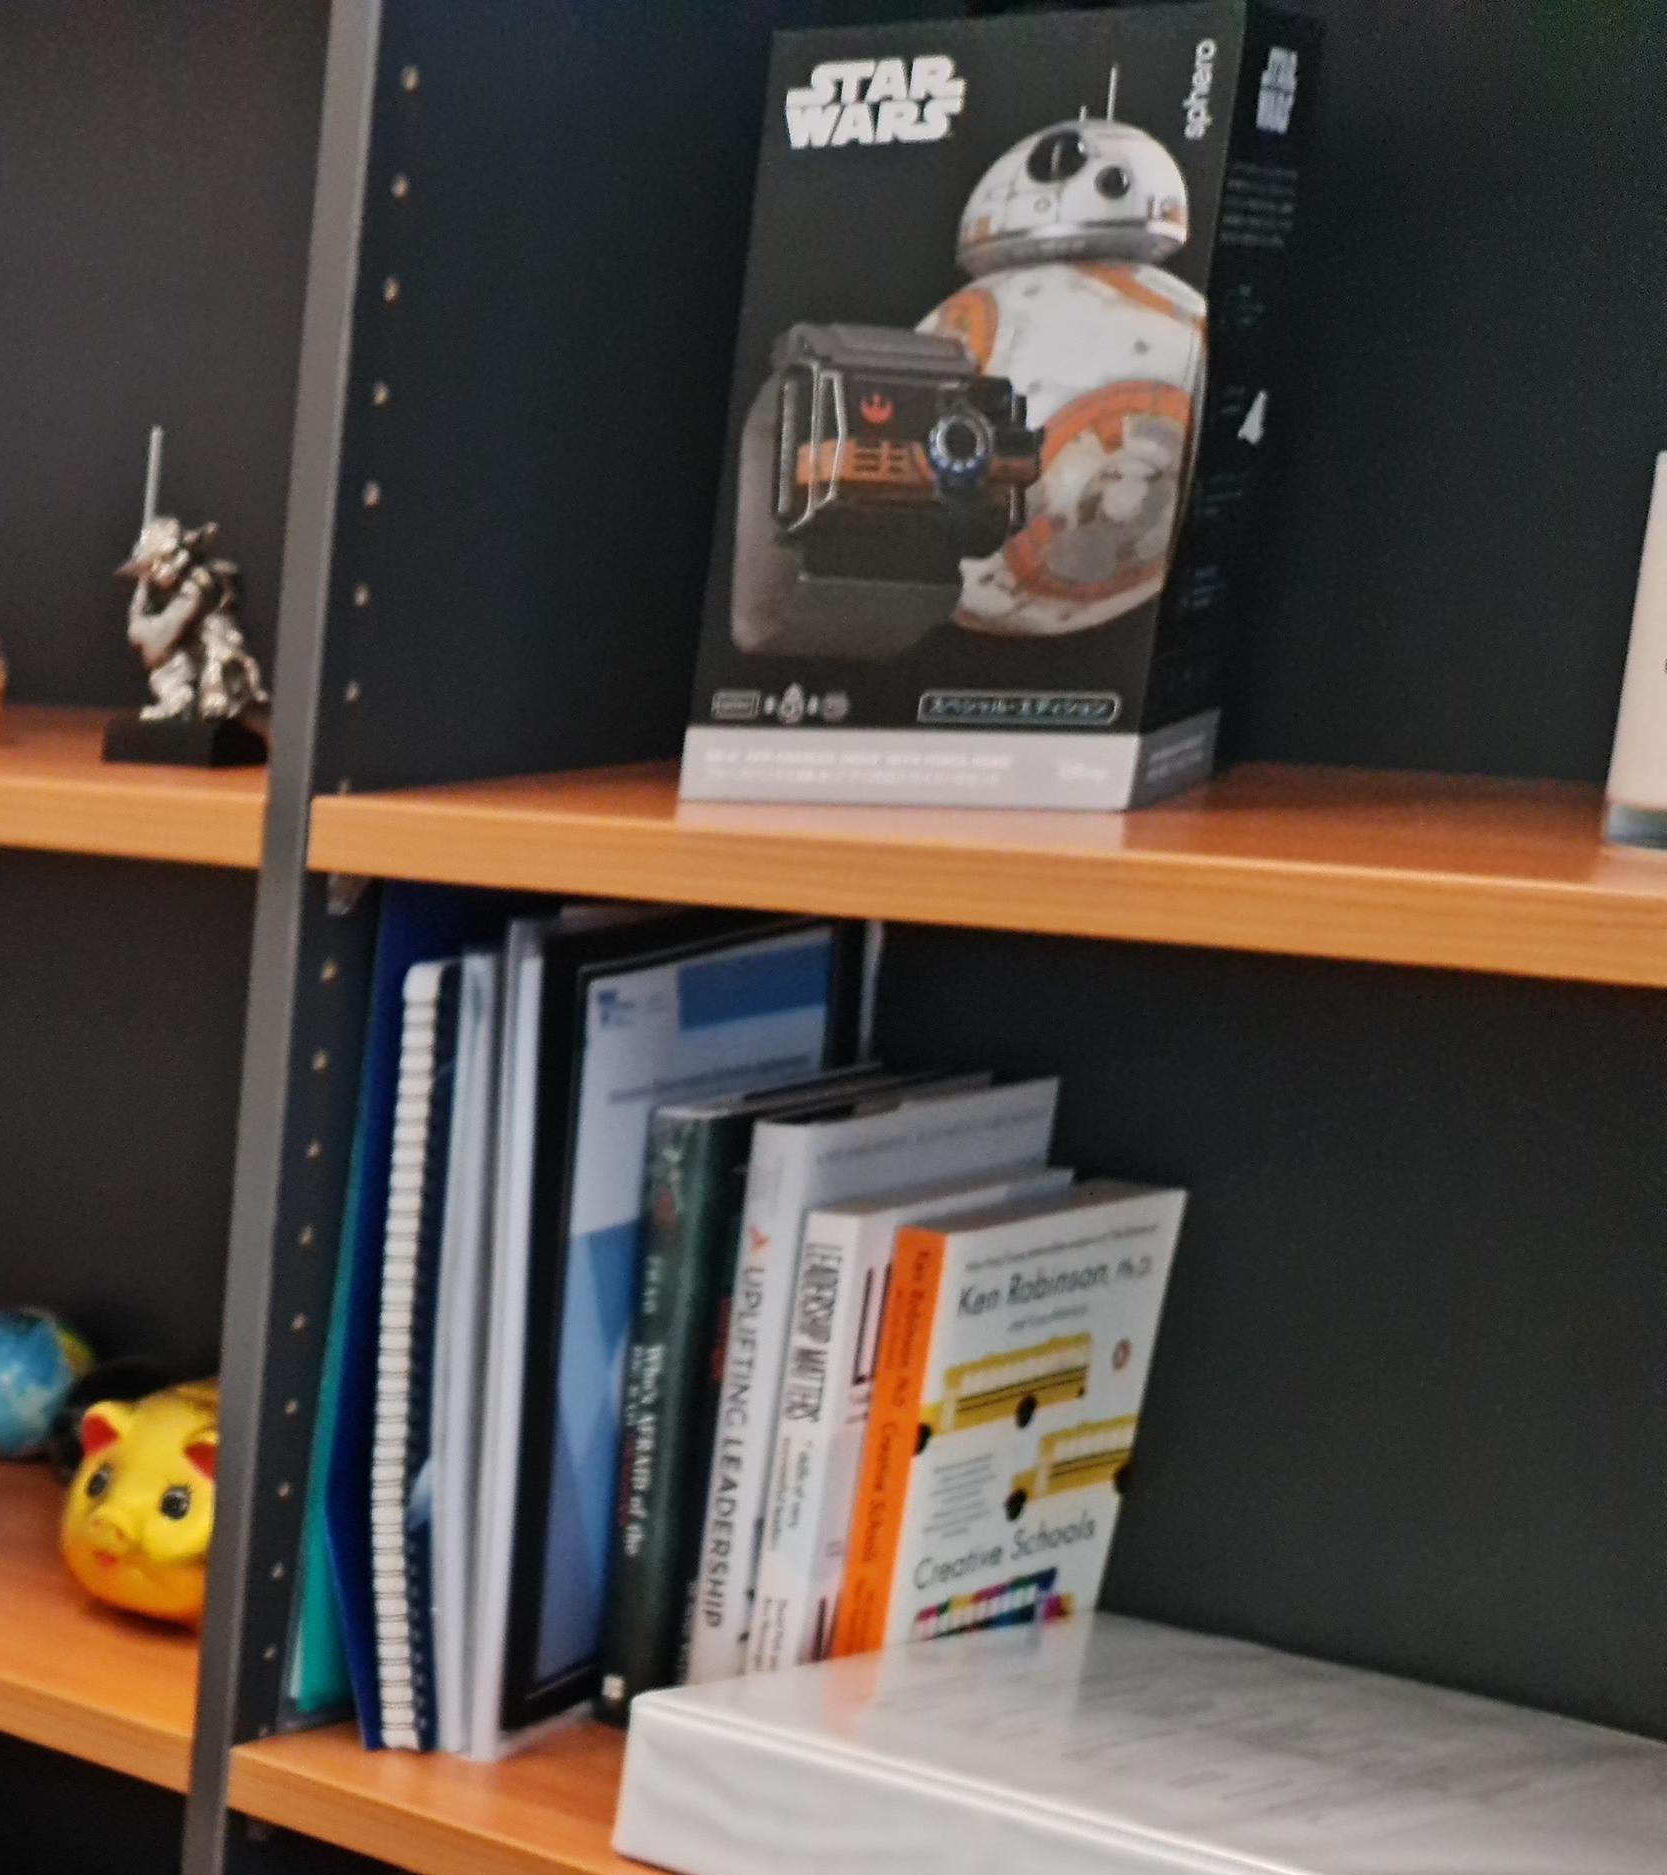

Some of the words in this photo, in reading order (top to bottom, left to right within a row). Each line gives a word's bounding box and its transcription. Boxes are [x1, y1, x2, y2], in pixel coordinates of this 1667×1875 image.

[786, 54, 967, 106] STAR
[1182, 37, 1217, 140] sphero
[786, 98, 965, 149] WARS
[797, 1243, 844, 1344] LEADERSHIP
[958, 1284, 1001, 1317] Ken
[724, 1266, 766, 1428] UPLIFTING
[781, 1348, 829, 1424] MATTERS
[704, 1437, 744, 1629] LEADERSHIP
[913, 1546, 1003, 1590] Creative
[1010, 1509, 1096, 1561] Schools
